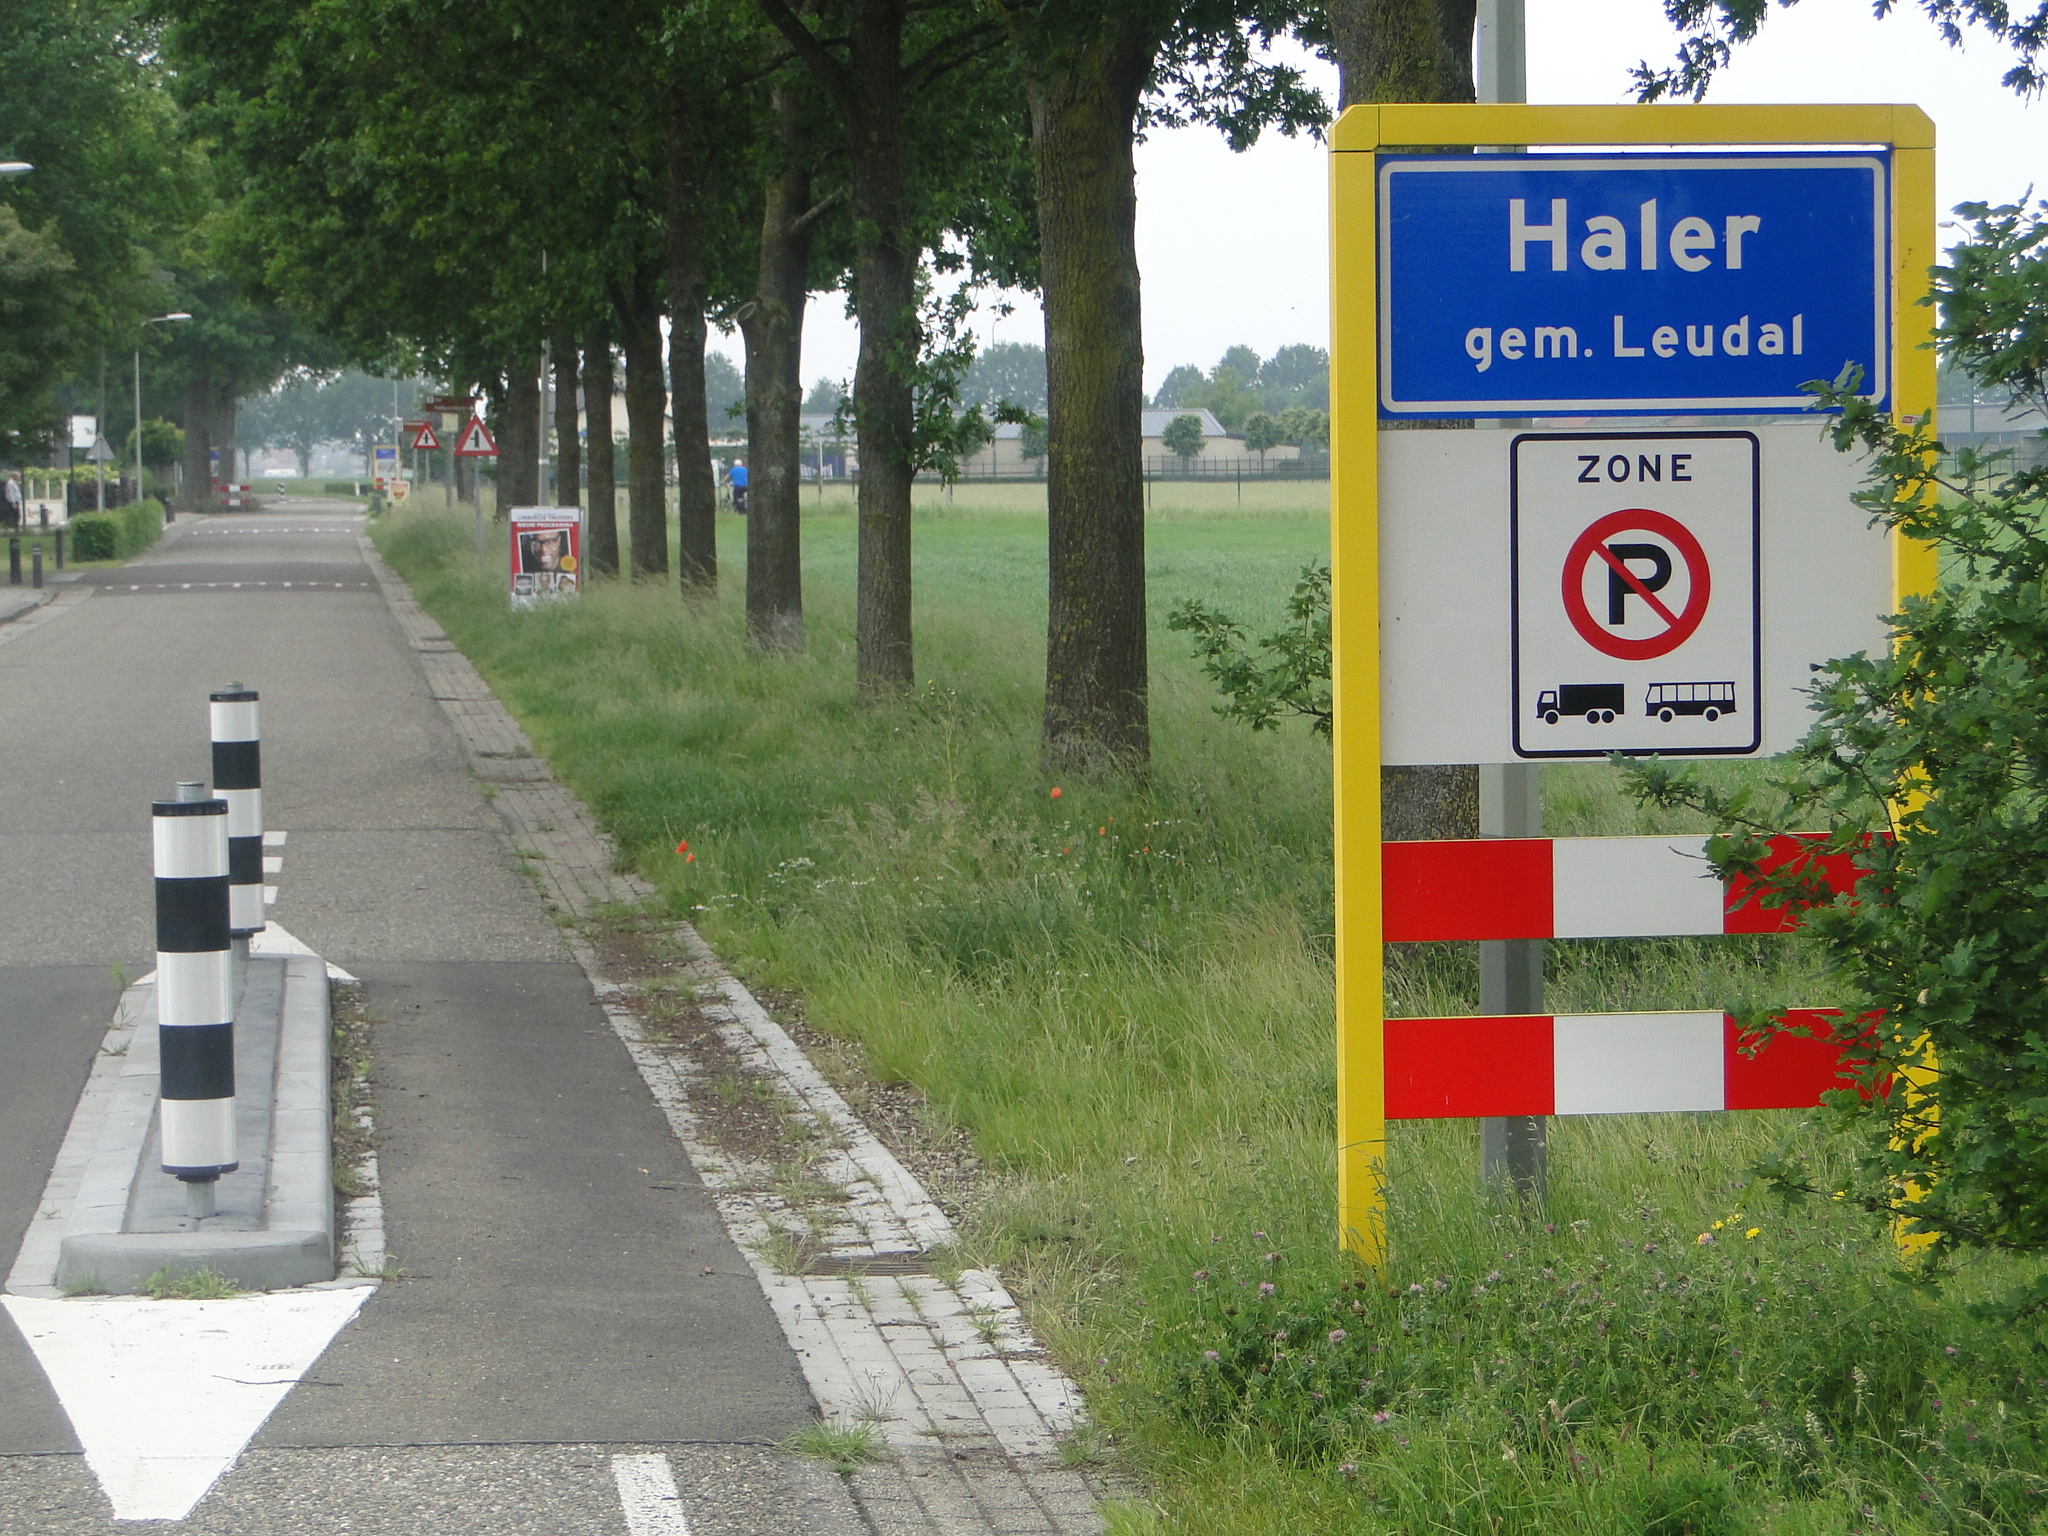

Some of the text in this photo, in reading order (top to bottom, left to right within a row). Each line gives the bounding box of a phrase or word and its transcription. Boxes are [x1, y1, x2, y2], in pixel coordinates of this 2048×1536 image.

[1509, 197, 1761, 273] Haler
[1464, 313, 1803, 374] gem. Leudal
[1577, 454, 1693, 483] ZONE
[1608, 543, 1672, 625] P
